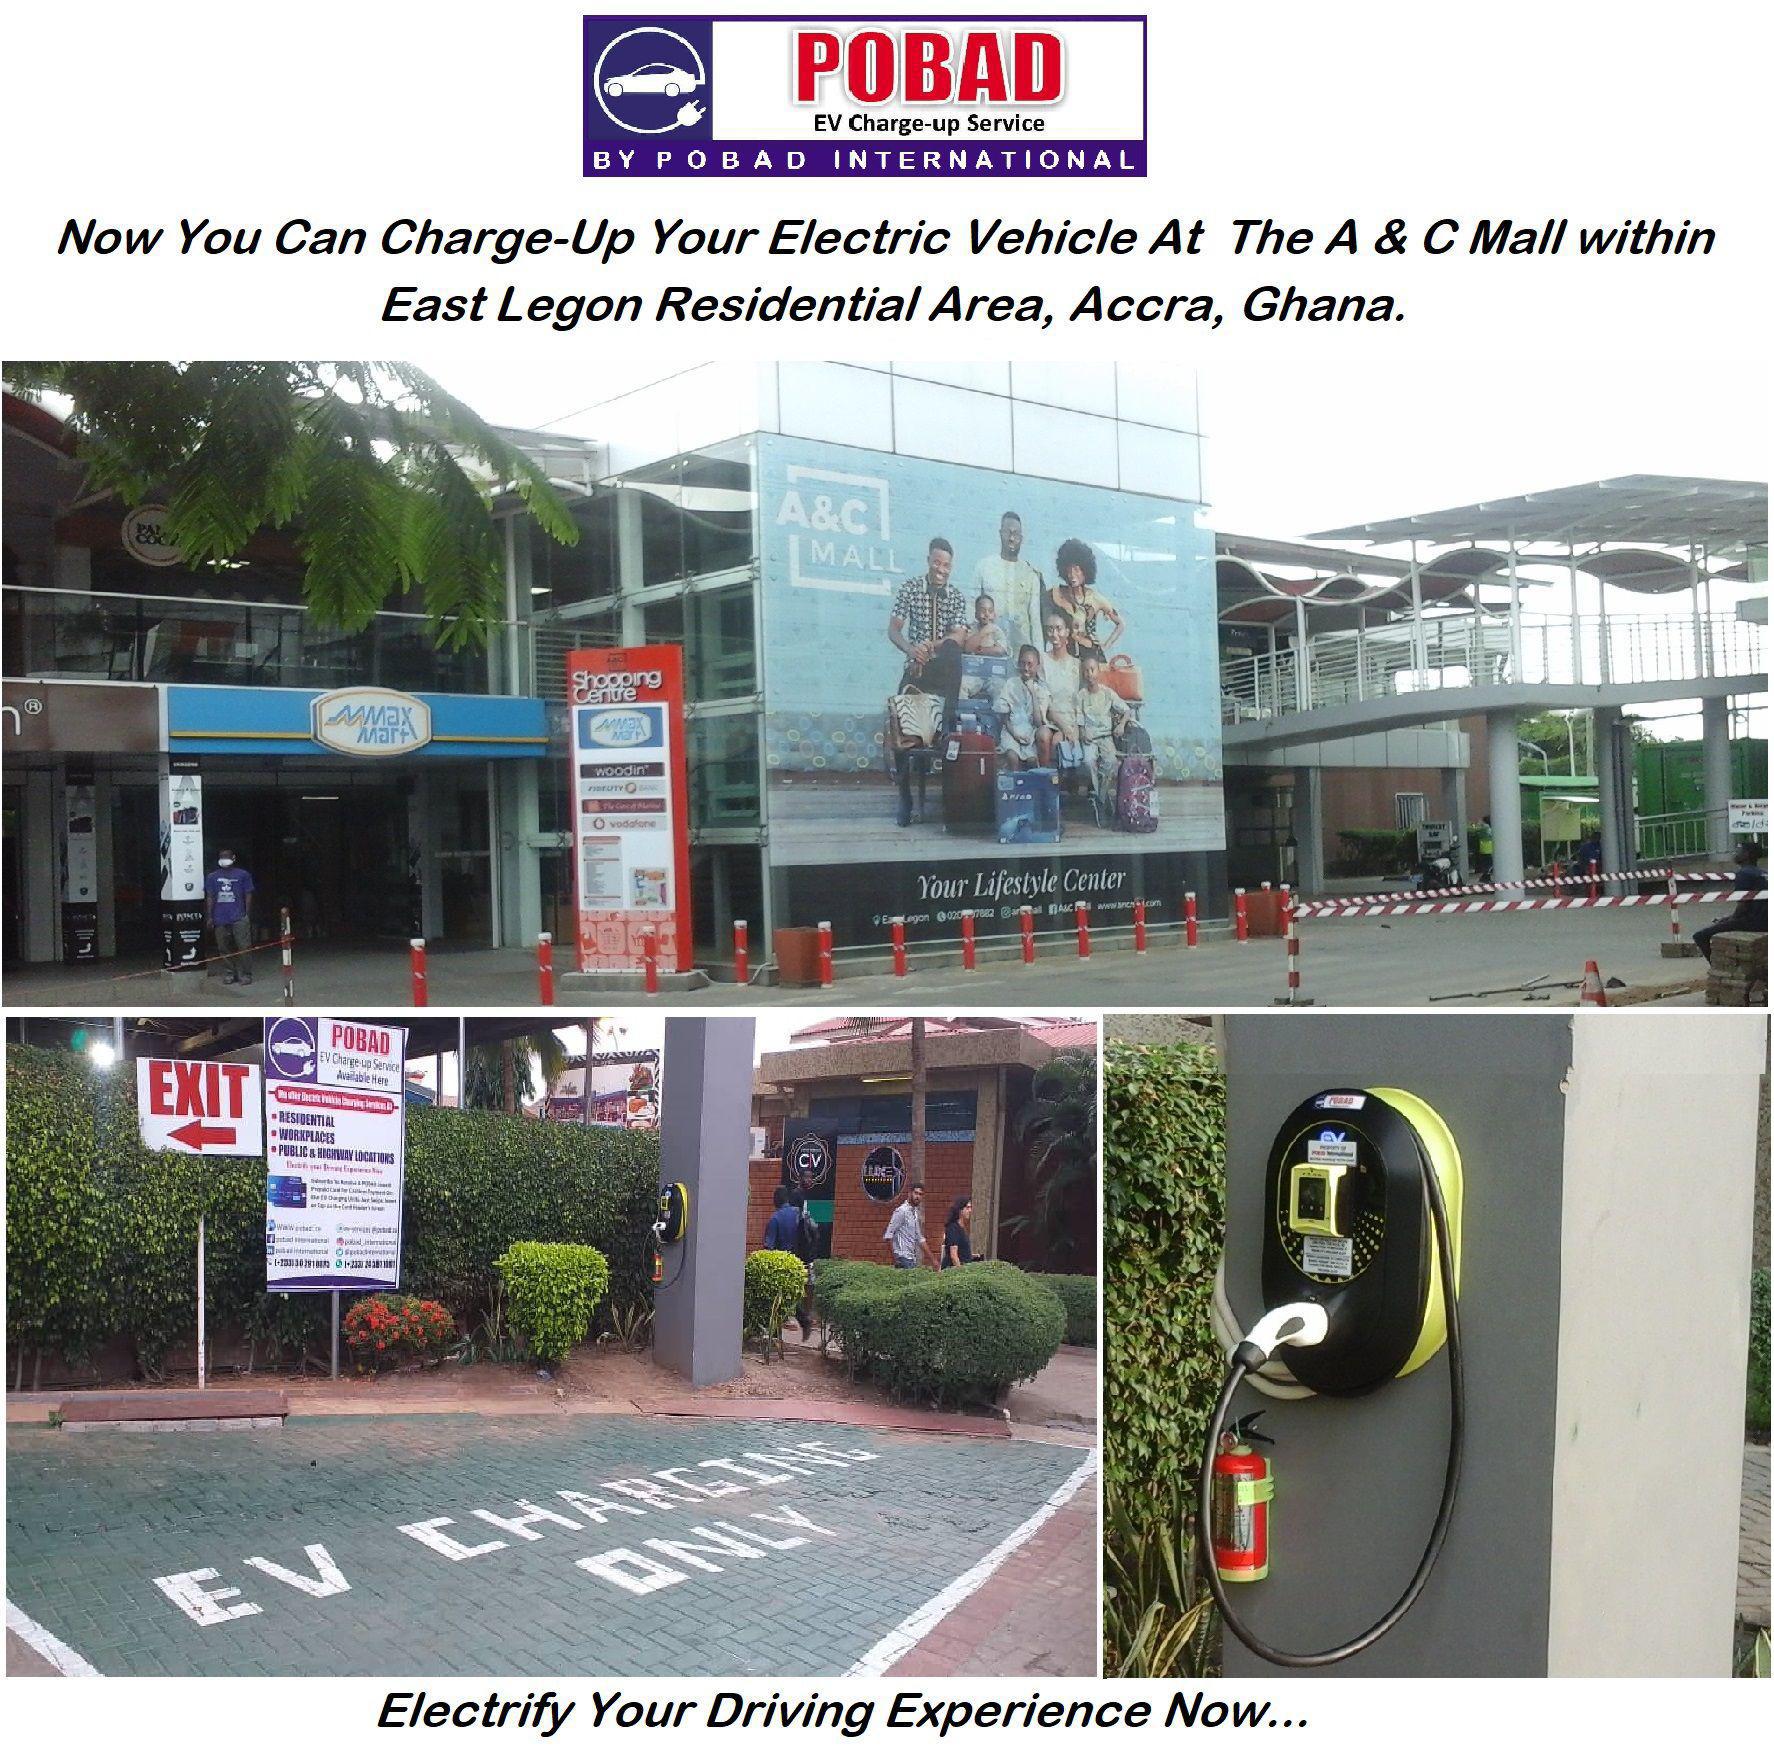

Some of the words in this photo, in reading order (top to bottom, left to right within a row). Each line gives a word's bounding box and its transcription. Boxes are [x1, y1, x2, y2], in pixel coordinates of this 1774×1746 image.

[776, 490, 868, 535] A&C
[811, 540, 904, 573] MALL
[573, 670, 662, 689] Shopping
[573, 688, 637, 704] Centre
[609, 819, 657, 829] vodafone
[917, 873, 968, 900] Your
[973, 868, 1058, 901] Lifestyle
[1064, 867, 1126, 892] Center
[332, 1024, 390, 1054] POBAD
[320, 1051, 331, 1063] EV
[333, 1053, 371, 1071] Charge-up
[373, 1058, 400, 1072] Service
[149, 1060, 249, 1118] EXIT
[337, 1070, 370, 1084] Available
[371, 1074, 389, 1086] Here
[279, 1111, 335, 1127] RESIDENTIAL
[279, 1129, 335, 1144] WORKPLACES
[279, 1144, 308, 1159] PUBLIC
[309, 1149, 316, 1158] &
[317, 1148, 354, 1161] HIGHWAY
[355, 1151, 395, 1165] LOCATIONS
[396, 1440, 880, 1561] CHARGING
[576, 1504, 837, 1596] ONLY
[152, 1543, 351, 1626] EV
